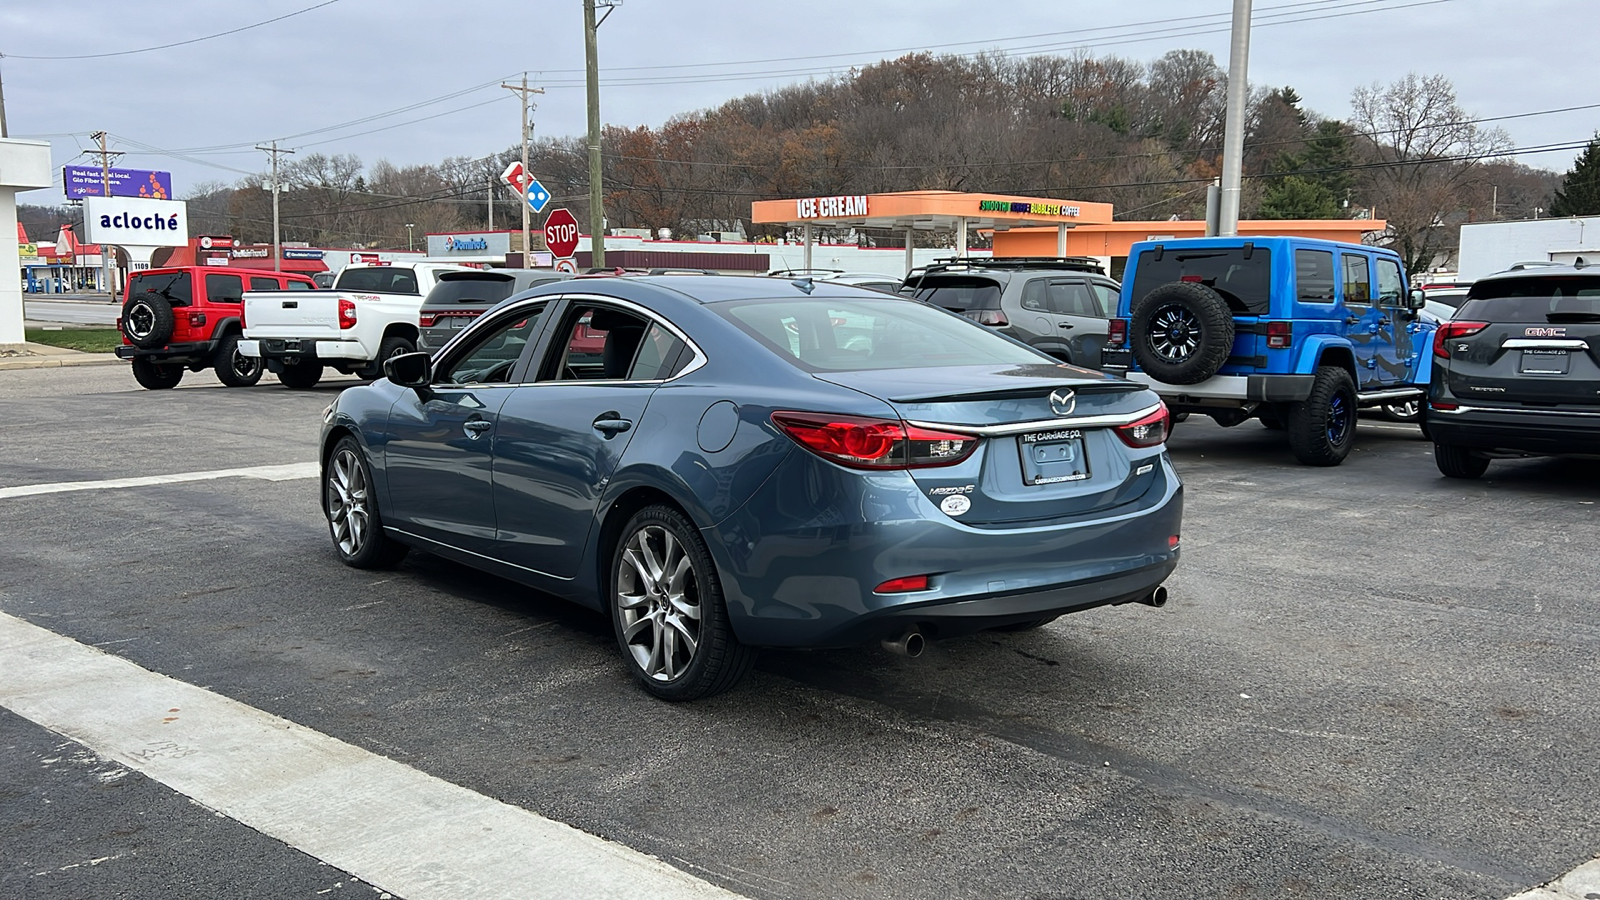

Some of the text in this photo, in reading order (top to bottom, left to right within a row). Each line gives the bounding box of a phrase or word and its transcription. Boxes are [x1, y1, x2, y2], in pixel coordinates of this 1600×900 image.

[796, 196, 869, 219] ICE CREAM
[100, 212, 178, 230] acloché
[547, 223, 576, 244] STOP
[453, 238, 488, 250] Domino's
[1524, 327, 1566, 337] GMC
[1024, 430, 1082, 442] THE CARRIAGE CO.
